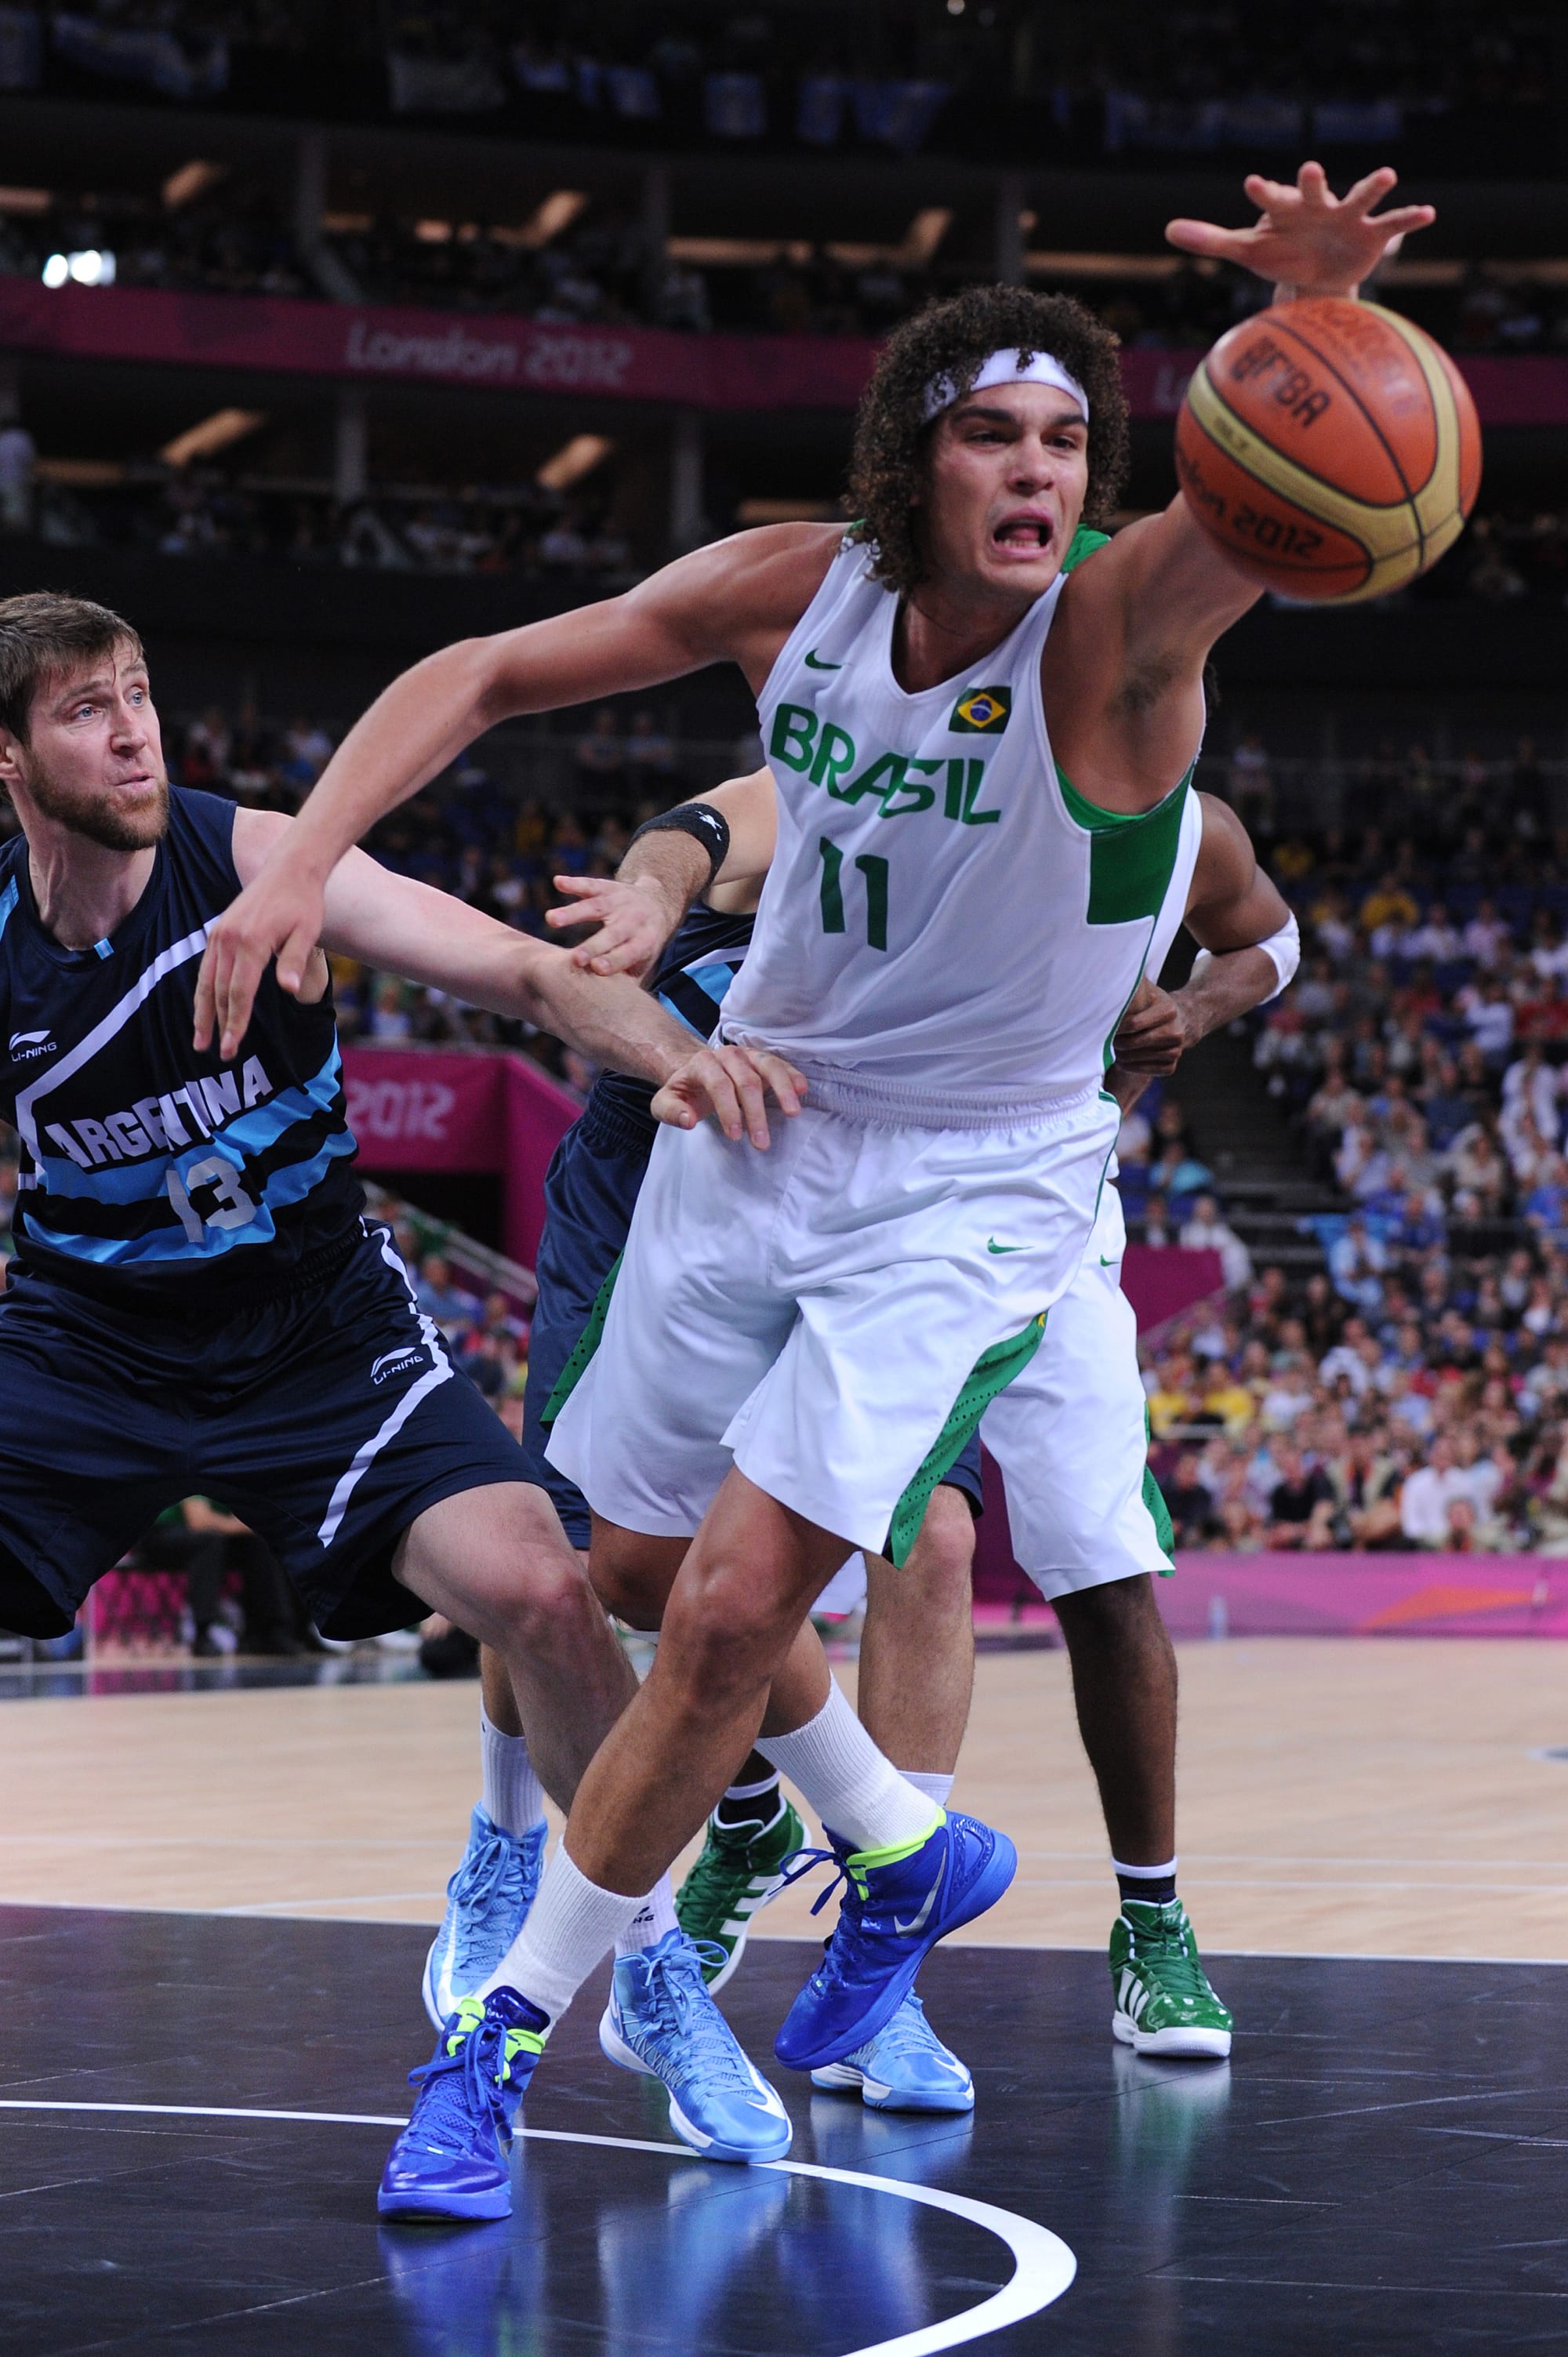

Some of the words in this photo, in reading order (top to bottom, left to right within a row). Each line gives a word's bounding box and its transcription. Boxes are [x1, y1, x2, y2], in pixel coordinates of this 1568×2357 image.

[346, 318, 518, 379] London
[526, 333, 633, 389] 2012
[1233, 503, 1324, 558] 2012
[769, 703, 1002, 825] BRASIL
[819, 836, 889, 952] 11
[11, 1041, 57, 1062] LI-NING
[44, 1055, 274, 1168] ARGENTINA
[343, 1077, 456, 1139] 2012
[165, 1156, 257, 1243] 13
